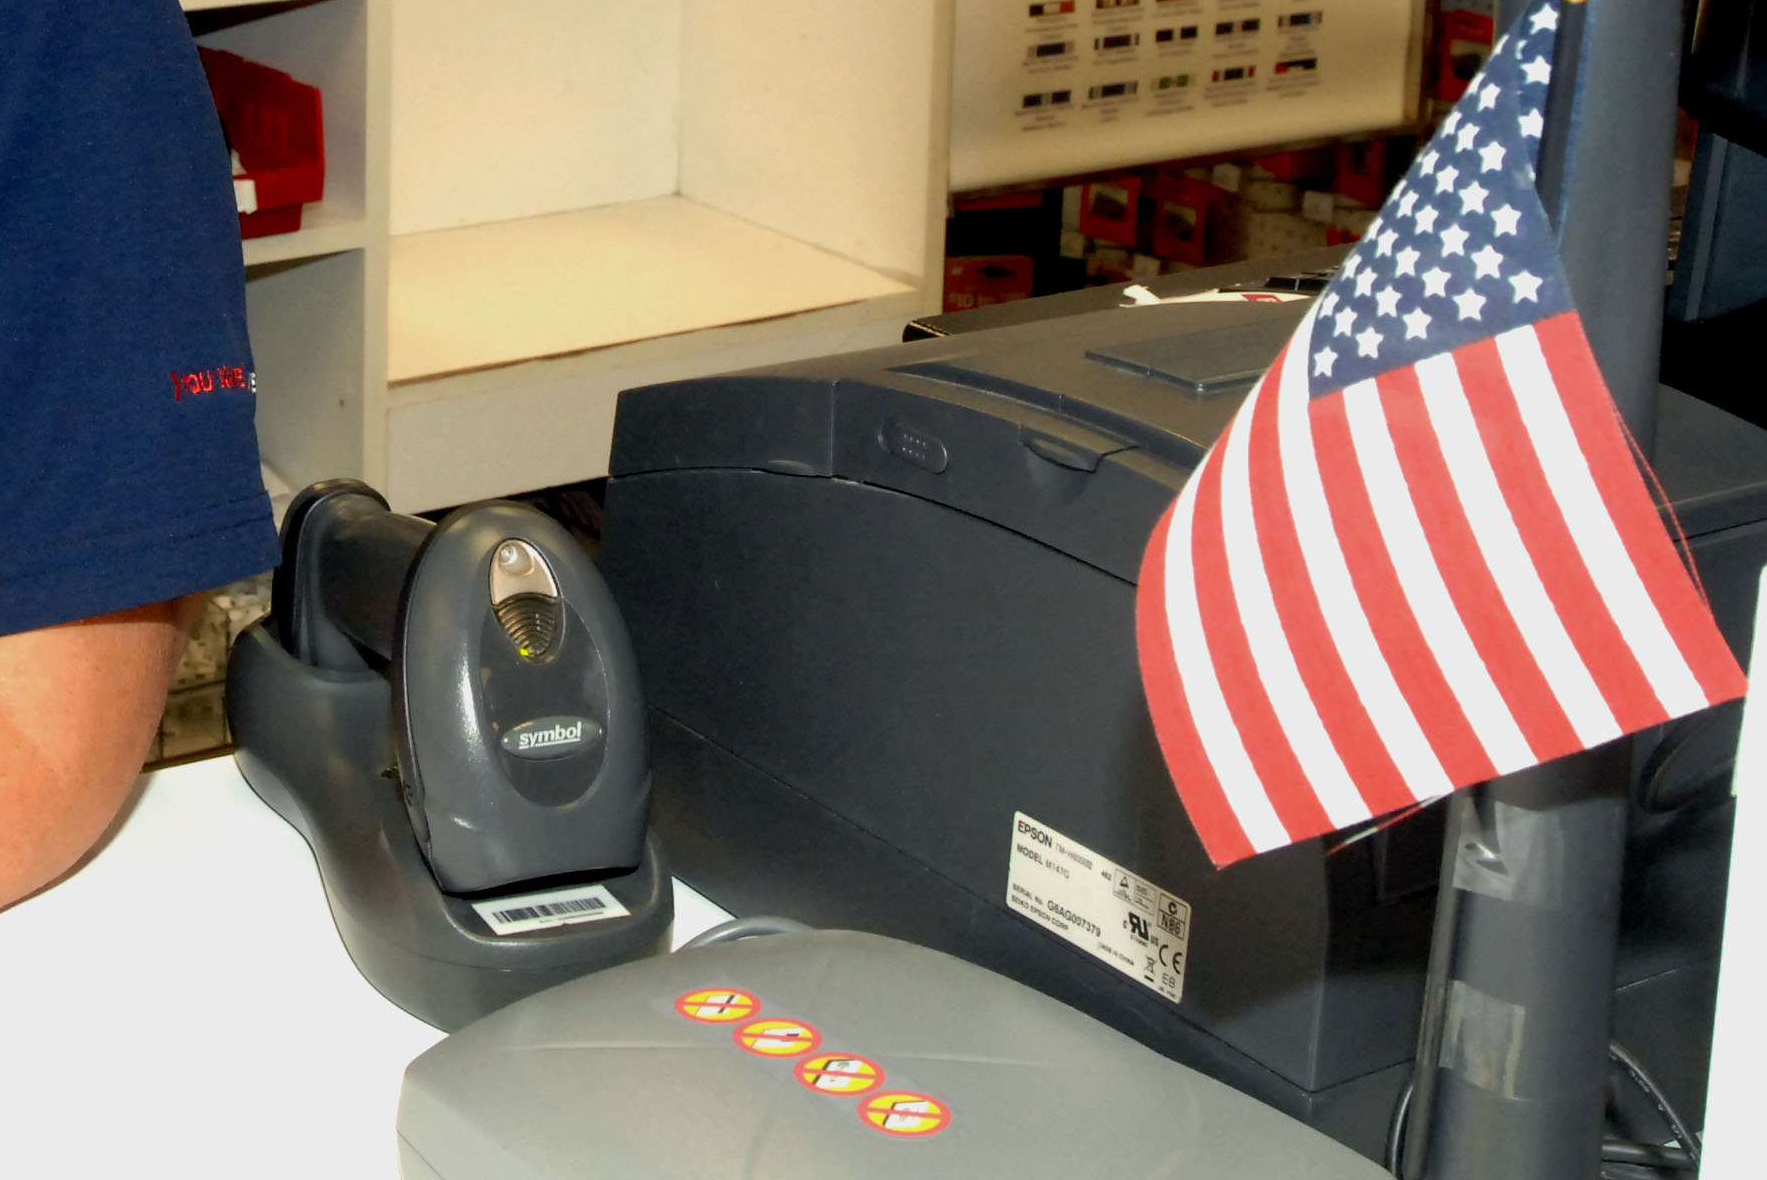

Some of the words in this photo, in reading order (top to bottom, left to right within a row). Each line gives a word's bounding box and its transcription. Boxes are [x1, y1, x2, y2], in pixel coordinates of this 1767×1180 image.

[519, 721, 581, 749] symbol
[1018, 819, 1053, 848] EPSON
[1017, 843, 1043, 866] MODEL
